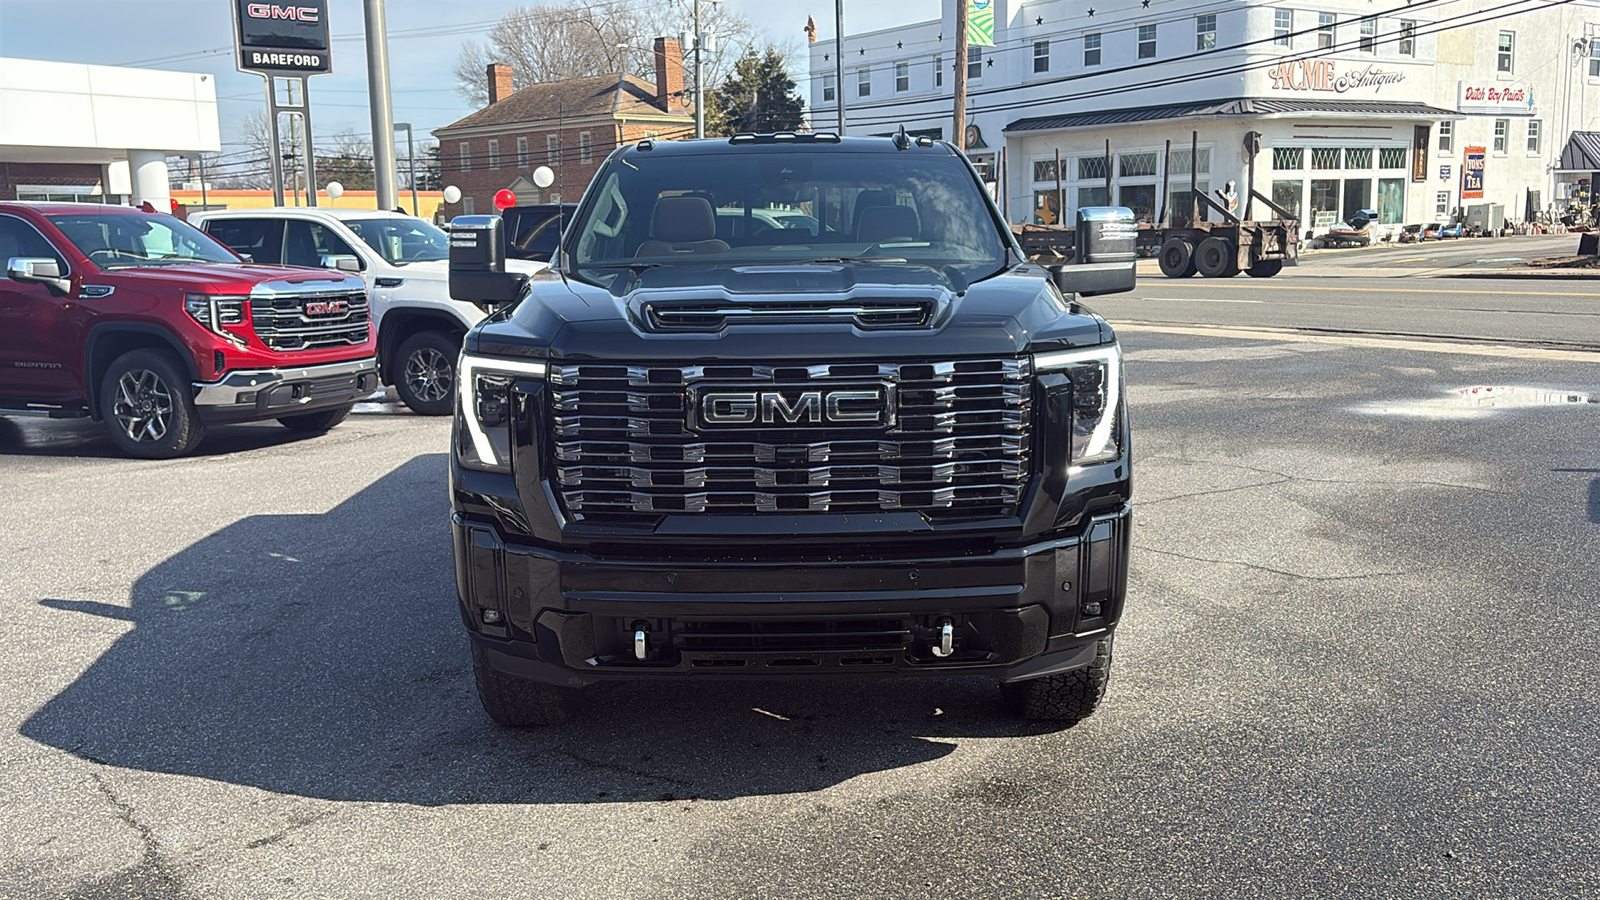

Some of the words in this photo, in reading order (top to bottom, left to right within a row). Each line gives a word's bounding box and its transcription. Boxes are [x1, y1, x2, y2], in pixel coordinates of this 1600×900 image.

[247, 3, 319, 22] GMC
[252, 52, 320, 66] BAREFORD
[1268, 58, 1336, 92] ACME
[1351, 63, 1406, 94] Antiques
[1465, 86, 1485, 101] Dutch
[1488, 87, 1502, 104] Boy
[1502, 87, 1525, 102] Paints
[1466, 174, 1481, 189] TEA
[306, 301, 348, 315] GMC
[703, 391, 880, 424] GMC
